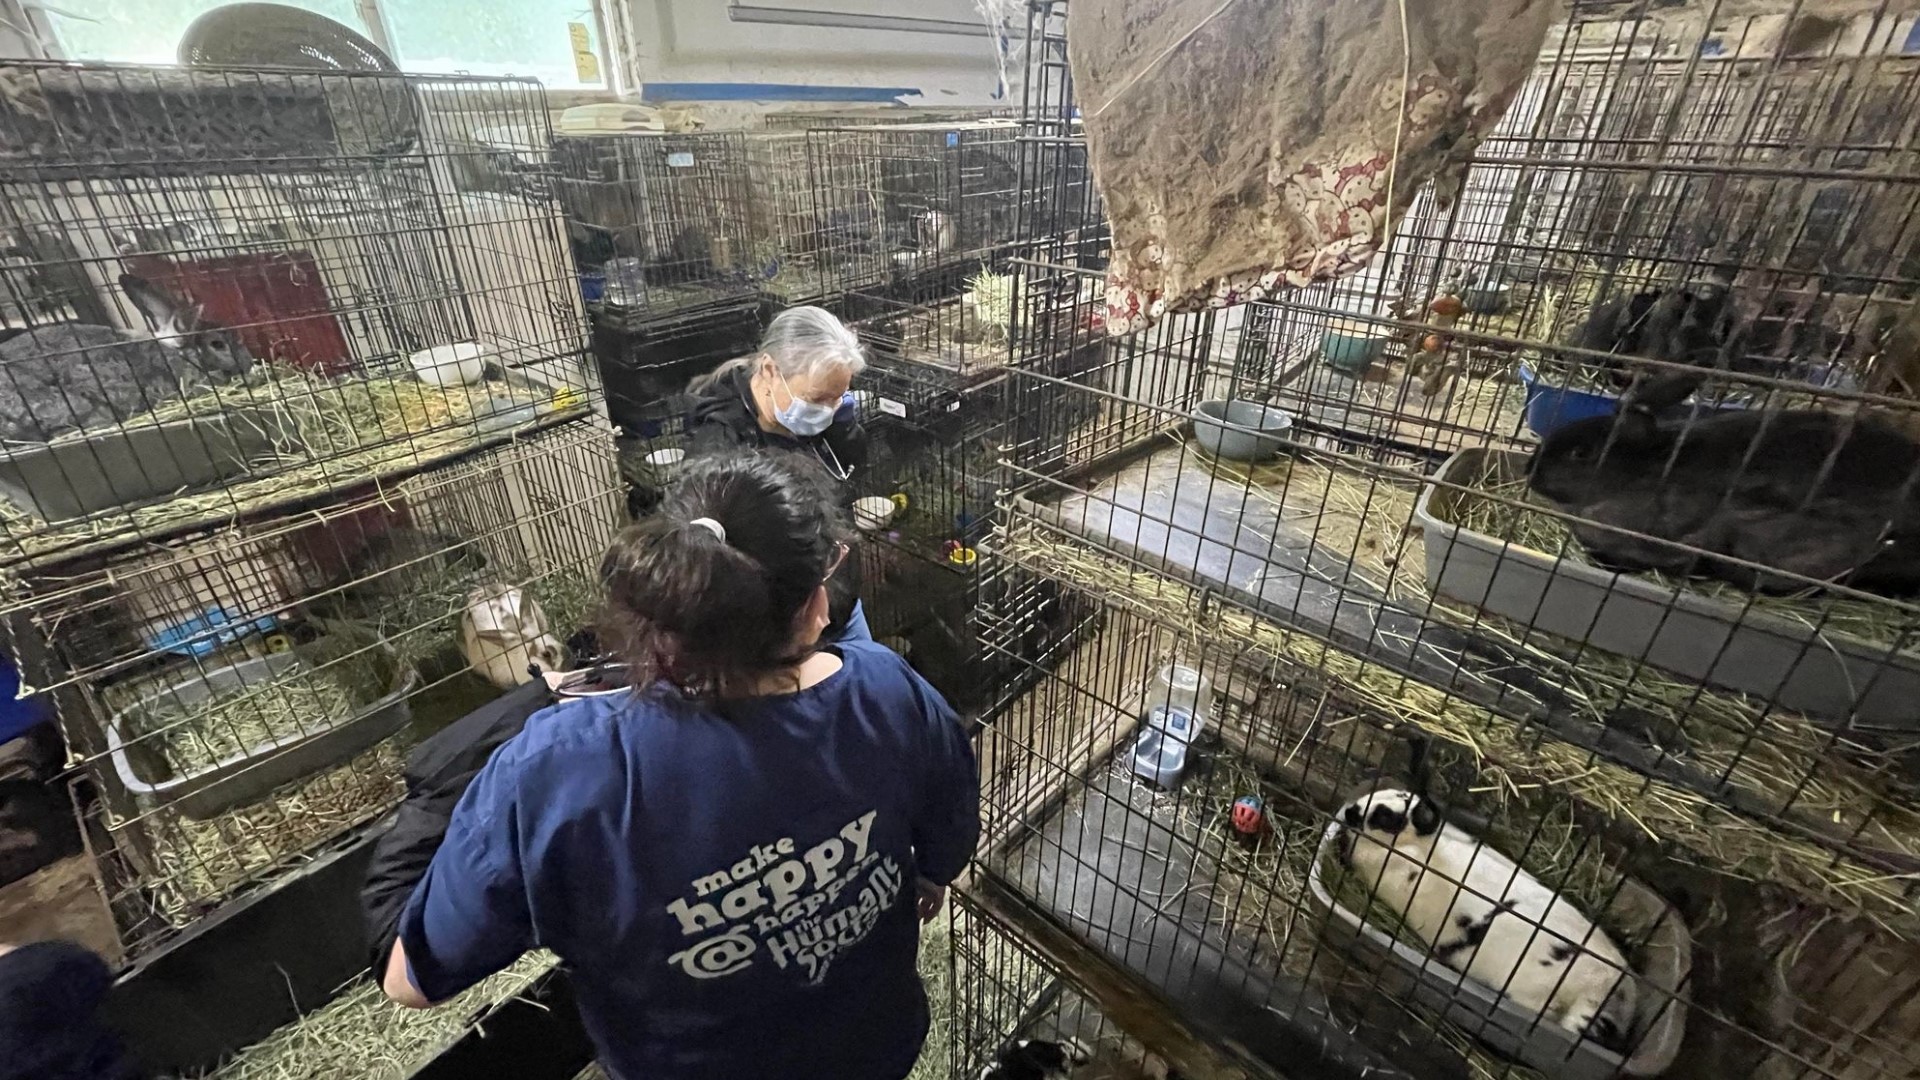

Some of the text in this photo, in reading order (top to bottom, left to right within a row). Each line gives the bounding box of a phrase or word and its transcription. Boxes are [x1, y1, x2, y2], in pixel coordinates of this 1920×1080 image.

[666, 810, 876, 935] happy
[692, 838, 794, 896] make
[668, 924, 756, 979] @
